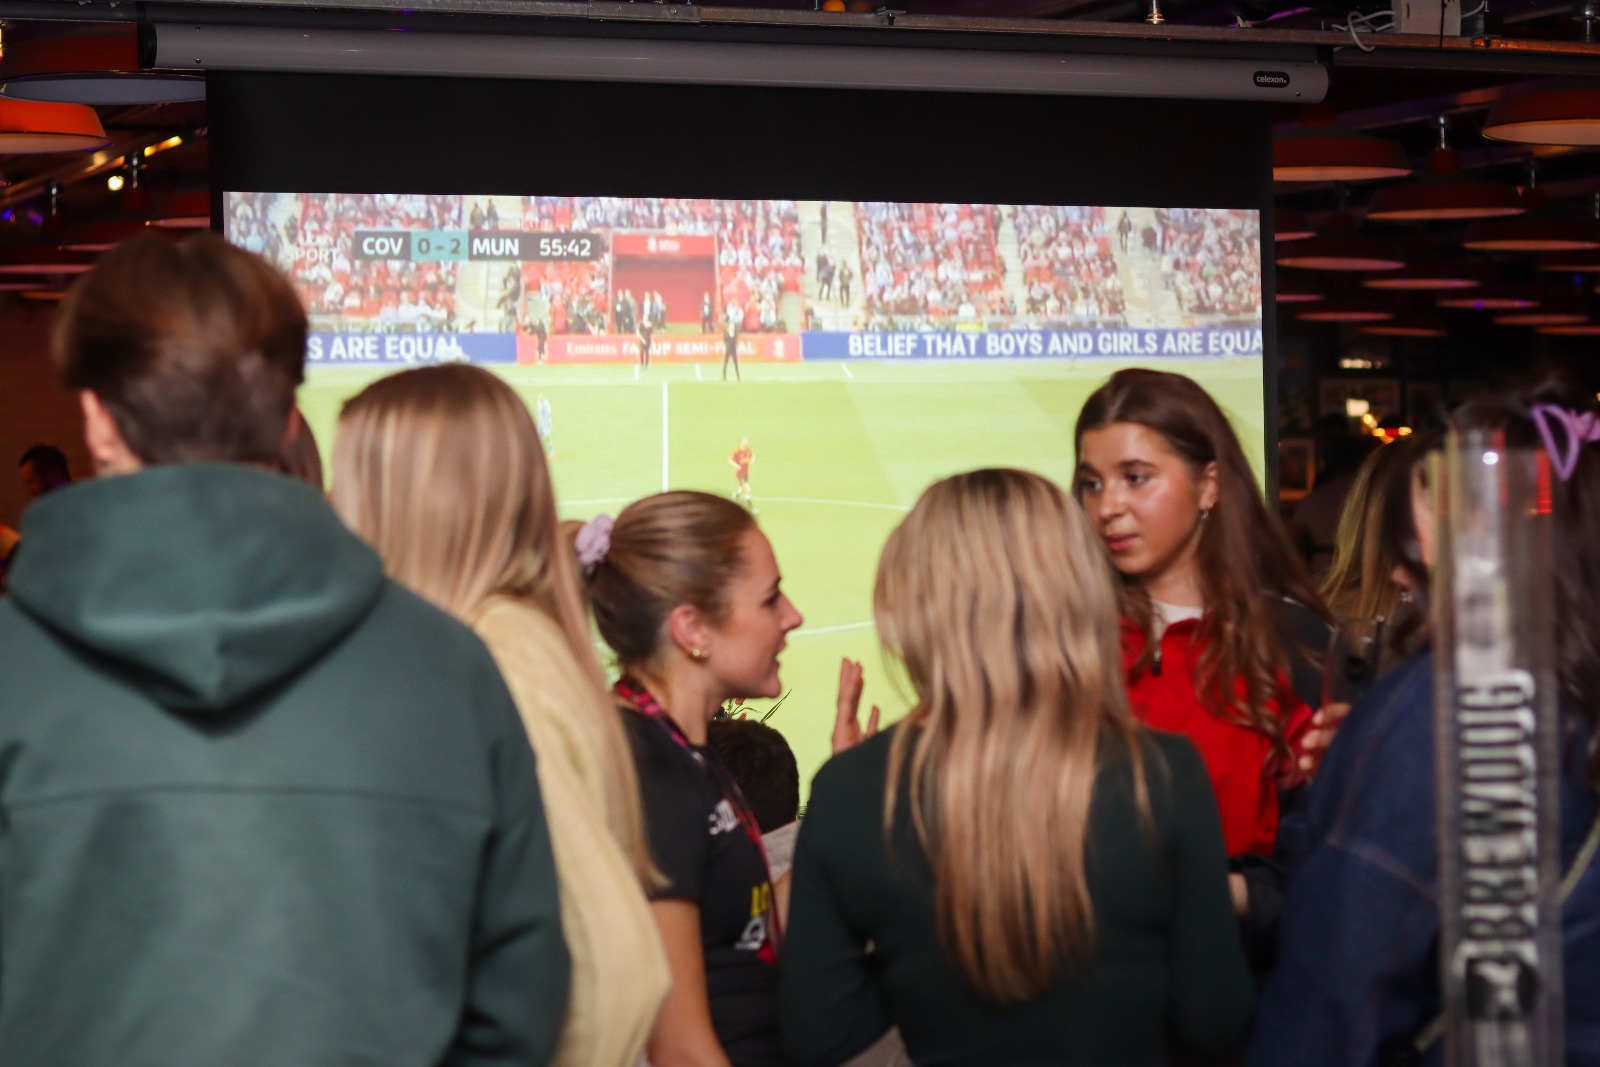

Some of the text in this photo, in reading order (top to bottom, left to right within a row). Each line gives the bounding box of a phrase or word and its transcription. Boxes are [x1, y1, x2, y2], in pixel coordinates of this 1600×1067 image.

[362, 237, 403, 256] COV
[418, 238, 431, 255] 0
[449, 238, 461, 255] 2
[472, 238, 519, 256] MUN
[539, 238, 591, 257] 55:42
[329, 335, 379, 360] ARE
[848, 333, 917, 356] BELIEF
[922, 333, 979, 356] THAT
[986, 333, 1043, 356] BOYS
[1049, 332, 1093, 354] AND
[1098, 332, 1158, 354] GIRLS
[1162, 331, 1203, 354] ARE
